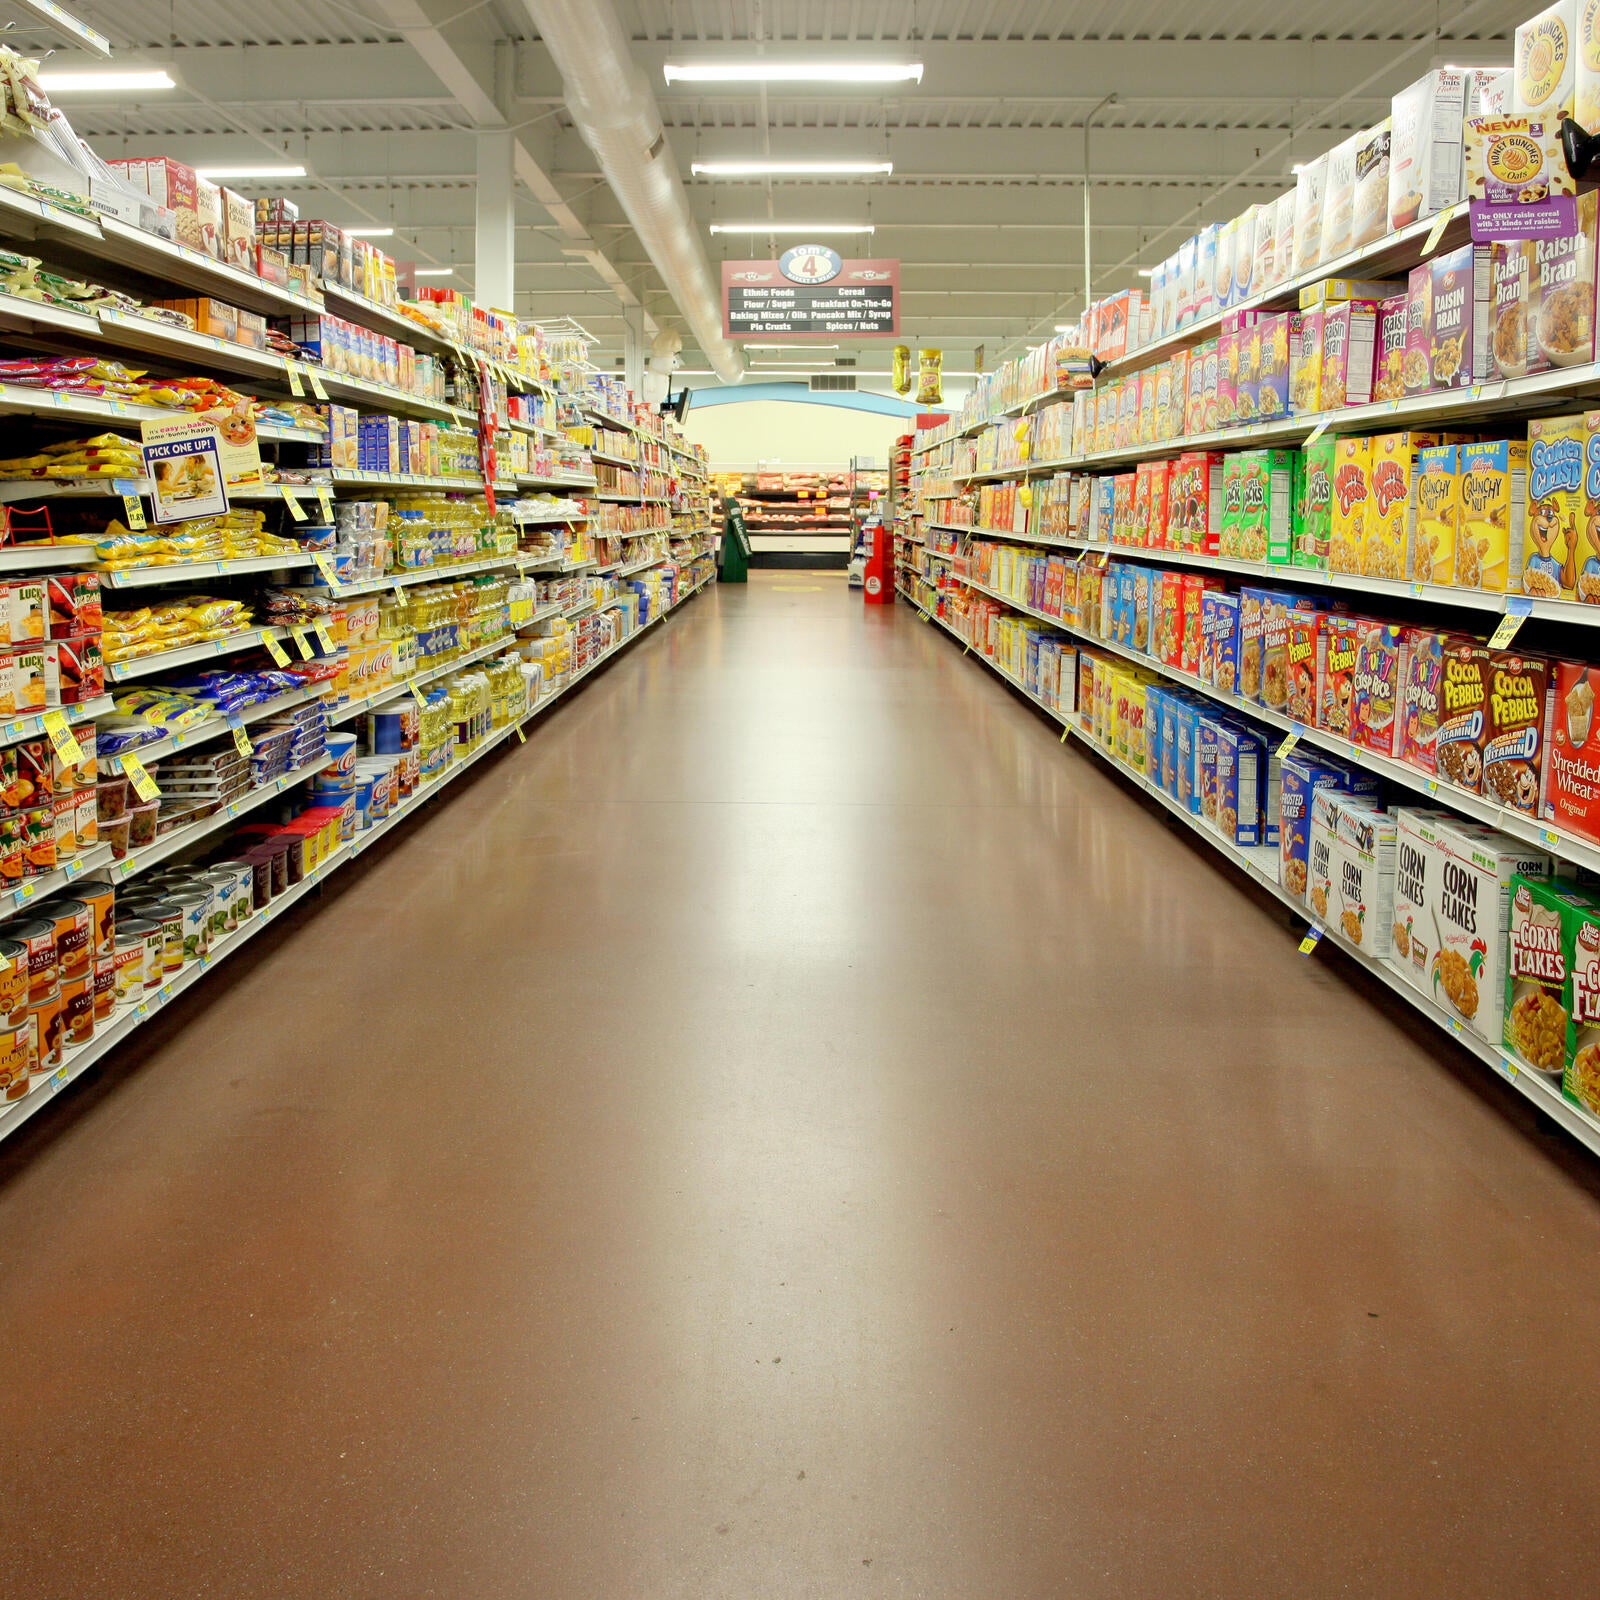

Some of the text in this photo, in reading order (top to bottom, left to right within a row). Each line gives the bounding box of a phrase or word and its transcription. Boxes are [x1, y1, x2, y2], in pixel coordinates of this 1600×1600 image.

[1537, 20, 1564, 62] BUNCHES
[1531, 79, 1551, 98] Oats
[1467, 118, 1485, 128] TRY
[1476, 118, 1528, 133] NEW!
[1491, 138, 1539, 166] HONEY BUNCHES
[1506, 171, 1528, 180] Oats
[1476, 220, 1492, 228] with
[1524, 218, 1532, 226] of
[1493, 212, 1512, 220] ONLY
[1537, 210, 1560, 218] cereal
[1534, 232, 1586, 265] Raisin
[802, 256, 818, 276] 4
[1493, 254, 1528, 284] Raisin
[1540, 258, 1577, 287] Bran
[743, 288, 795, 297] Ethnic Foods
[838, 288, 866, 296] Cereal
[1434, 287, 1464, 310] RAISIN
[1496, 280, 1521, 306] Bran
[744, 300, 764, 308] Flour
[772, 300, 796, 310] Sugar
[812, 300, 892, 308] Breakfast On-The-Go
[730, 312, 758, 320] Baking
[760, 311, 784, 320] Mixes
[792, 311, 808, 319] Oils
[811, 311, 845, 319] Pancake
[847, 311, 862, 319] Mix
[868, 310, 892, 320] Syrup
[1383, 310, 1407, 335] Raisi
[1436, 308, 1460, 330] BRAN
[750, 322, 791, 330] Pie Crusts
[826, 322, 853, 331] Spices
[860, 322, 879, 330] Nuts
[1324, 319, 1345, 341] Raisin
[1326, 338, 1342, 359] Bran
[148, 440, 210, 458] PICK ONE UP!
[1422, 448, 1450, 460] NEW!
[1466, 444, 1500, 456] NEW!
[1532, 438, 1582, 467] Golden
[1471, 458, 1494, 472] Kellogg's
[1418, 475, 1450, 505] CRUNCHY
[1462, 473, 1502, 506] CRUNCHY
[1426, 496, 1438, 510] NUT
[1472, 497, 1486, 512] NUT
[76, 592, 101, 609] PEAC
[1261, 618, 1286, 636] Froste
[1265, 632, 1287, 650] Flake
[19, 656, 44, 669] LUCK
[1288, 642, 1312, 664] PEBBLES
[1446, 658, 1482, 683] COCOA
[1494, 670, 1534, 698] COCOA
[1444, 680, 1484, 711] PEBBLES
[1491, 694, 1539, 727] PEBBLES
[1438, 710, 1483, 742] VITAMIN D
[1444, 714, 1472, 727] EXCELLENT
[1485, 726, 1538, 760] VITAMIN D
[1492, 730, 1526, 745] EXCELLENT
[1552, 748, 1600, 782] Shredded
[1556, 770, 1592, 800] Wheat
[1282, 792, 1304, 806] FROSTED
[1560, 798, 1587, 817] Original
[1282, 804, 1300, 818] FLAKES
[1342, 812, 1358, 830] WIN
[1314, 839, 1330, 865] CORN
[1434, 840, 1455, 858] Kellogg's
[1314, 856, 1328, 880] FLAKES
[1400, 842, 1426, 884] CORN
[1516, 861, 1543, 872] CORN
[1342, 860, 1362, 887] CORN
[1342, 878, 1362, 903] FLAKES
[1398, 868, 1424, 908] FLAKES
[1443, 860, 1478, 908] CORN
[1442, 890, 1477, 935] FLAKES
[65, 928, 89, 946] PUMP
[147, 934, 162, 948] LUC
[1520, 920, 1560, 953] CORN
[116, 947, 144, 964] WILDE
[1510, 930, 1566, 982] FLAKES
